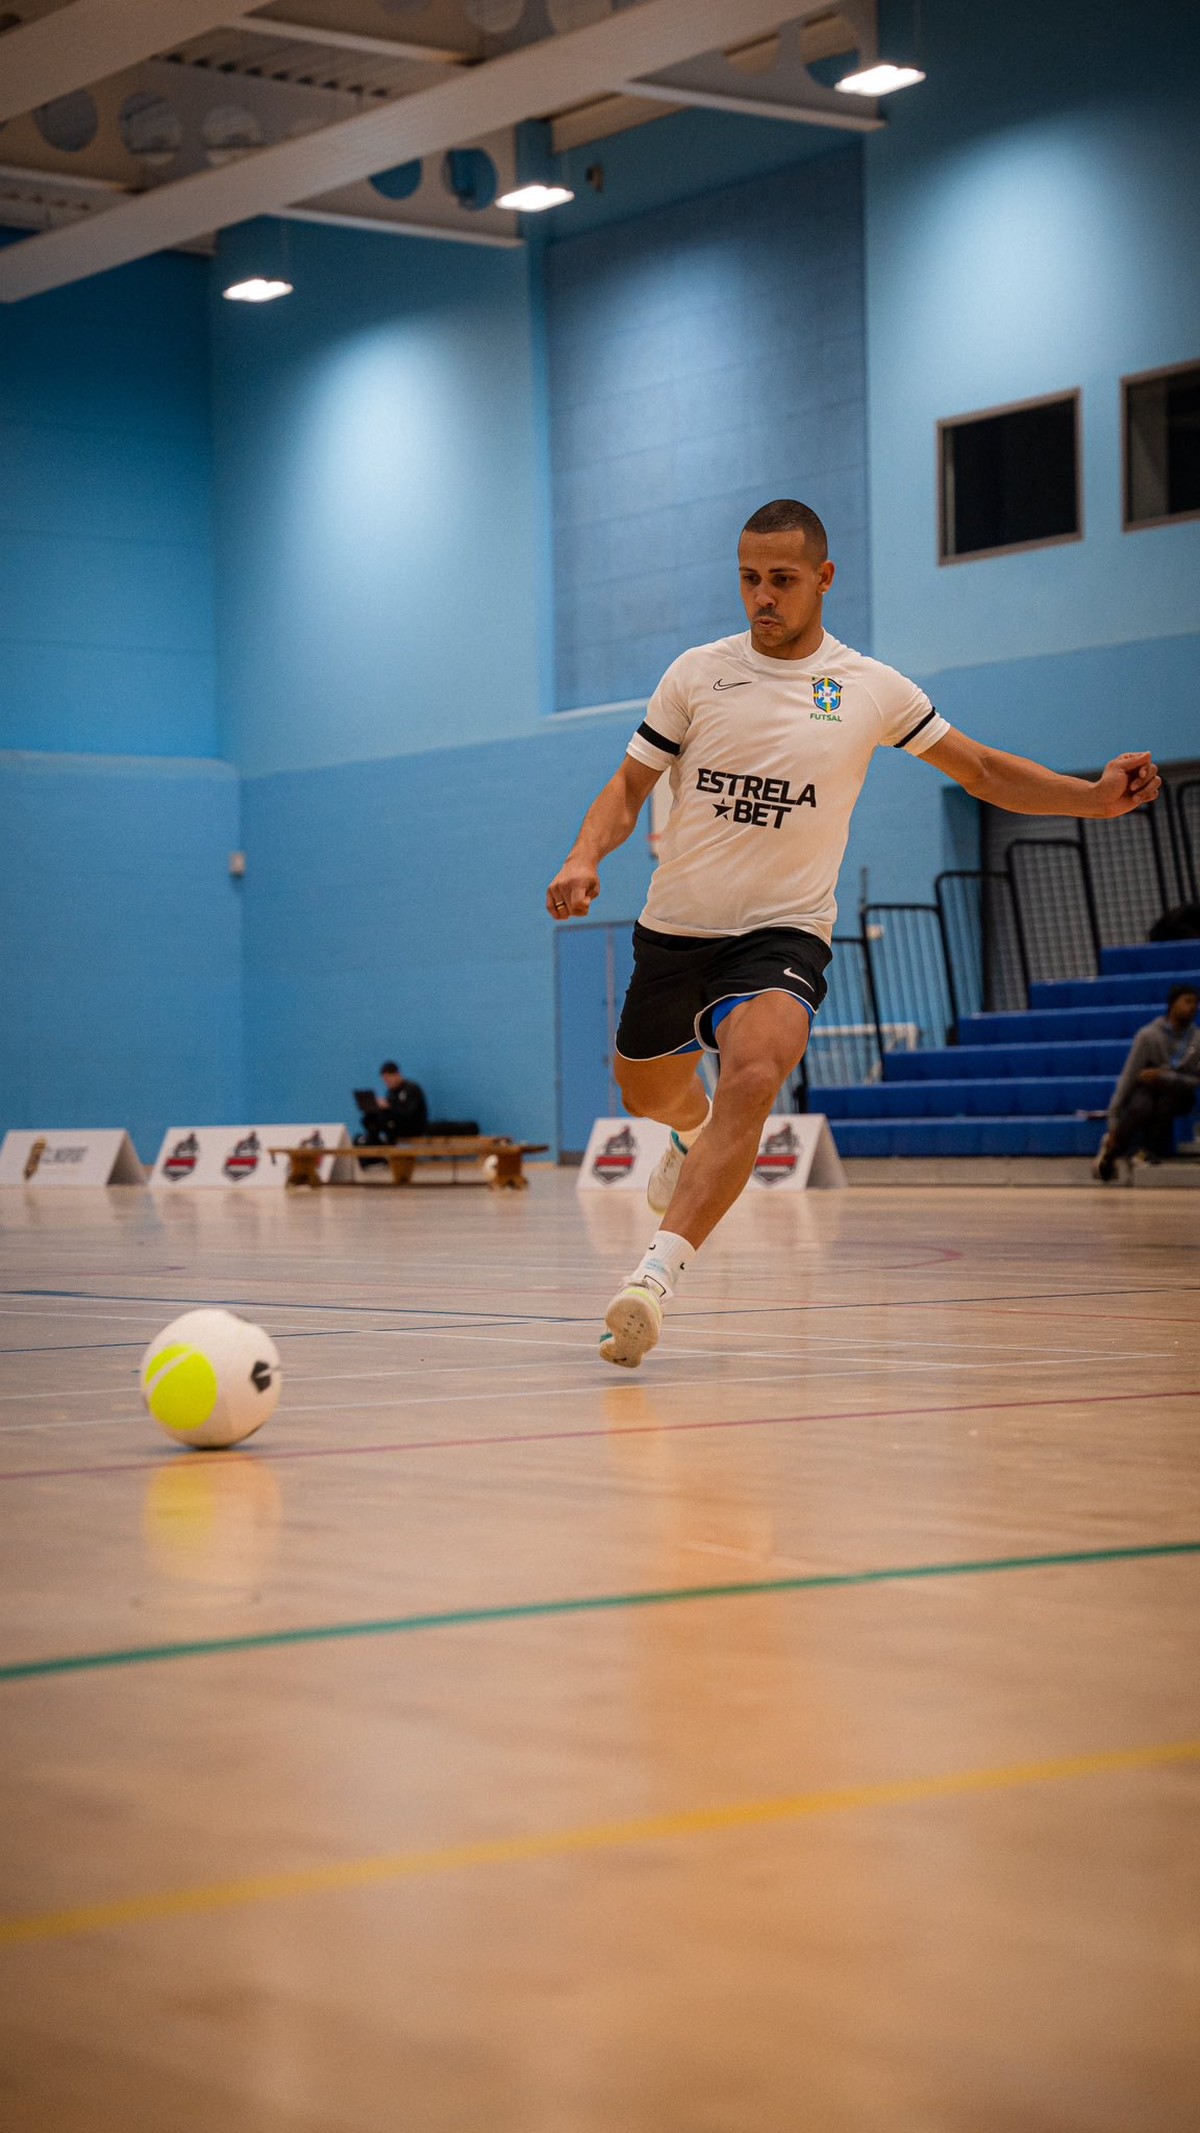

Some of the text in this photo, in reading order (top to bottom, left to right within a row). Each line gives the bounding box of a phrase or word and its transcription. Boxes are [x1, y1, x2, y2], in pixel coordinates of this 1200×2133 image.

[810, 713, 842, 722] FUTSAL
[696, 768, 816, 808] ESTRELA
[733, 799, 792, 829] BET
